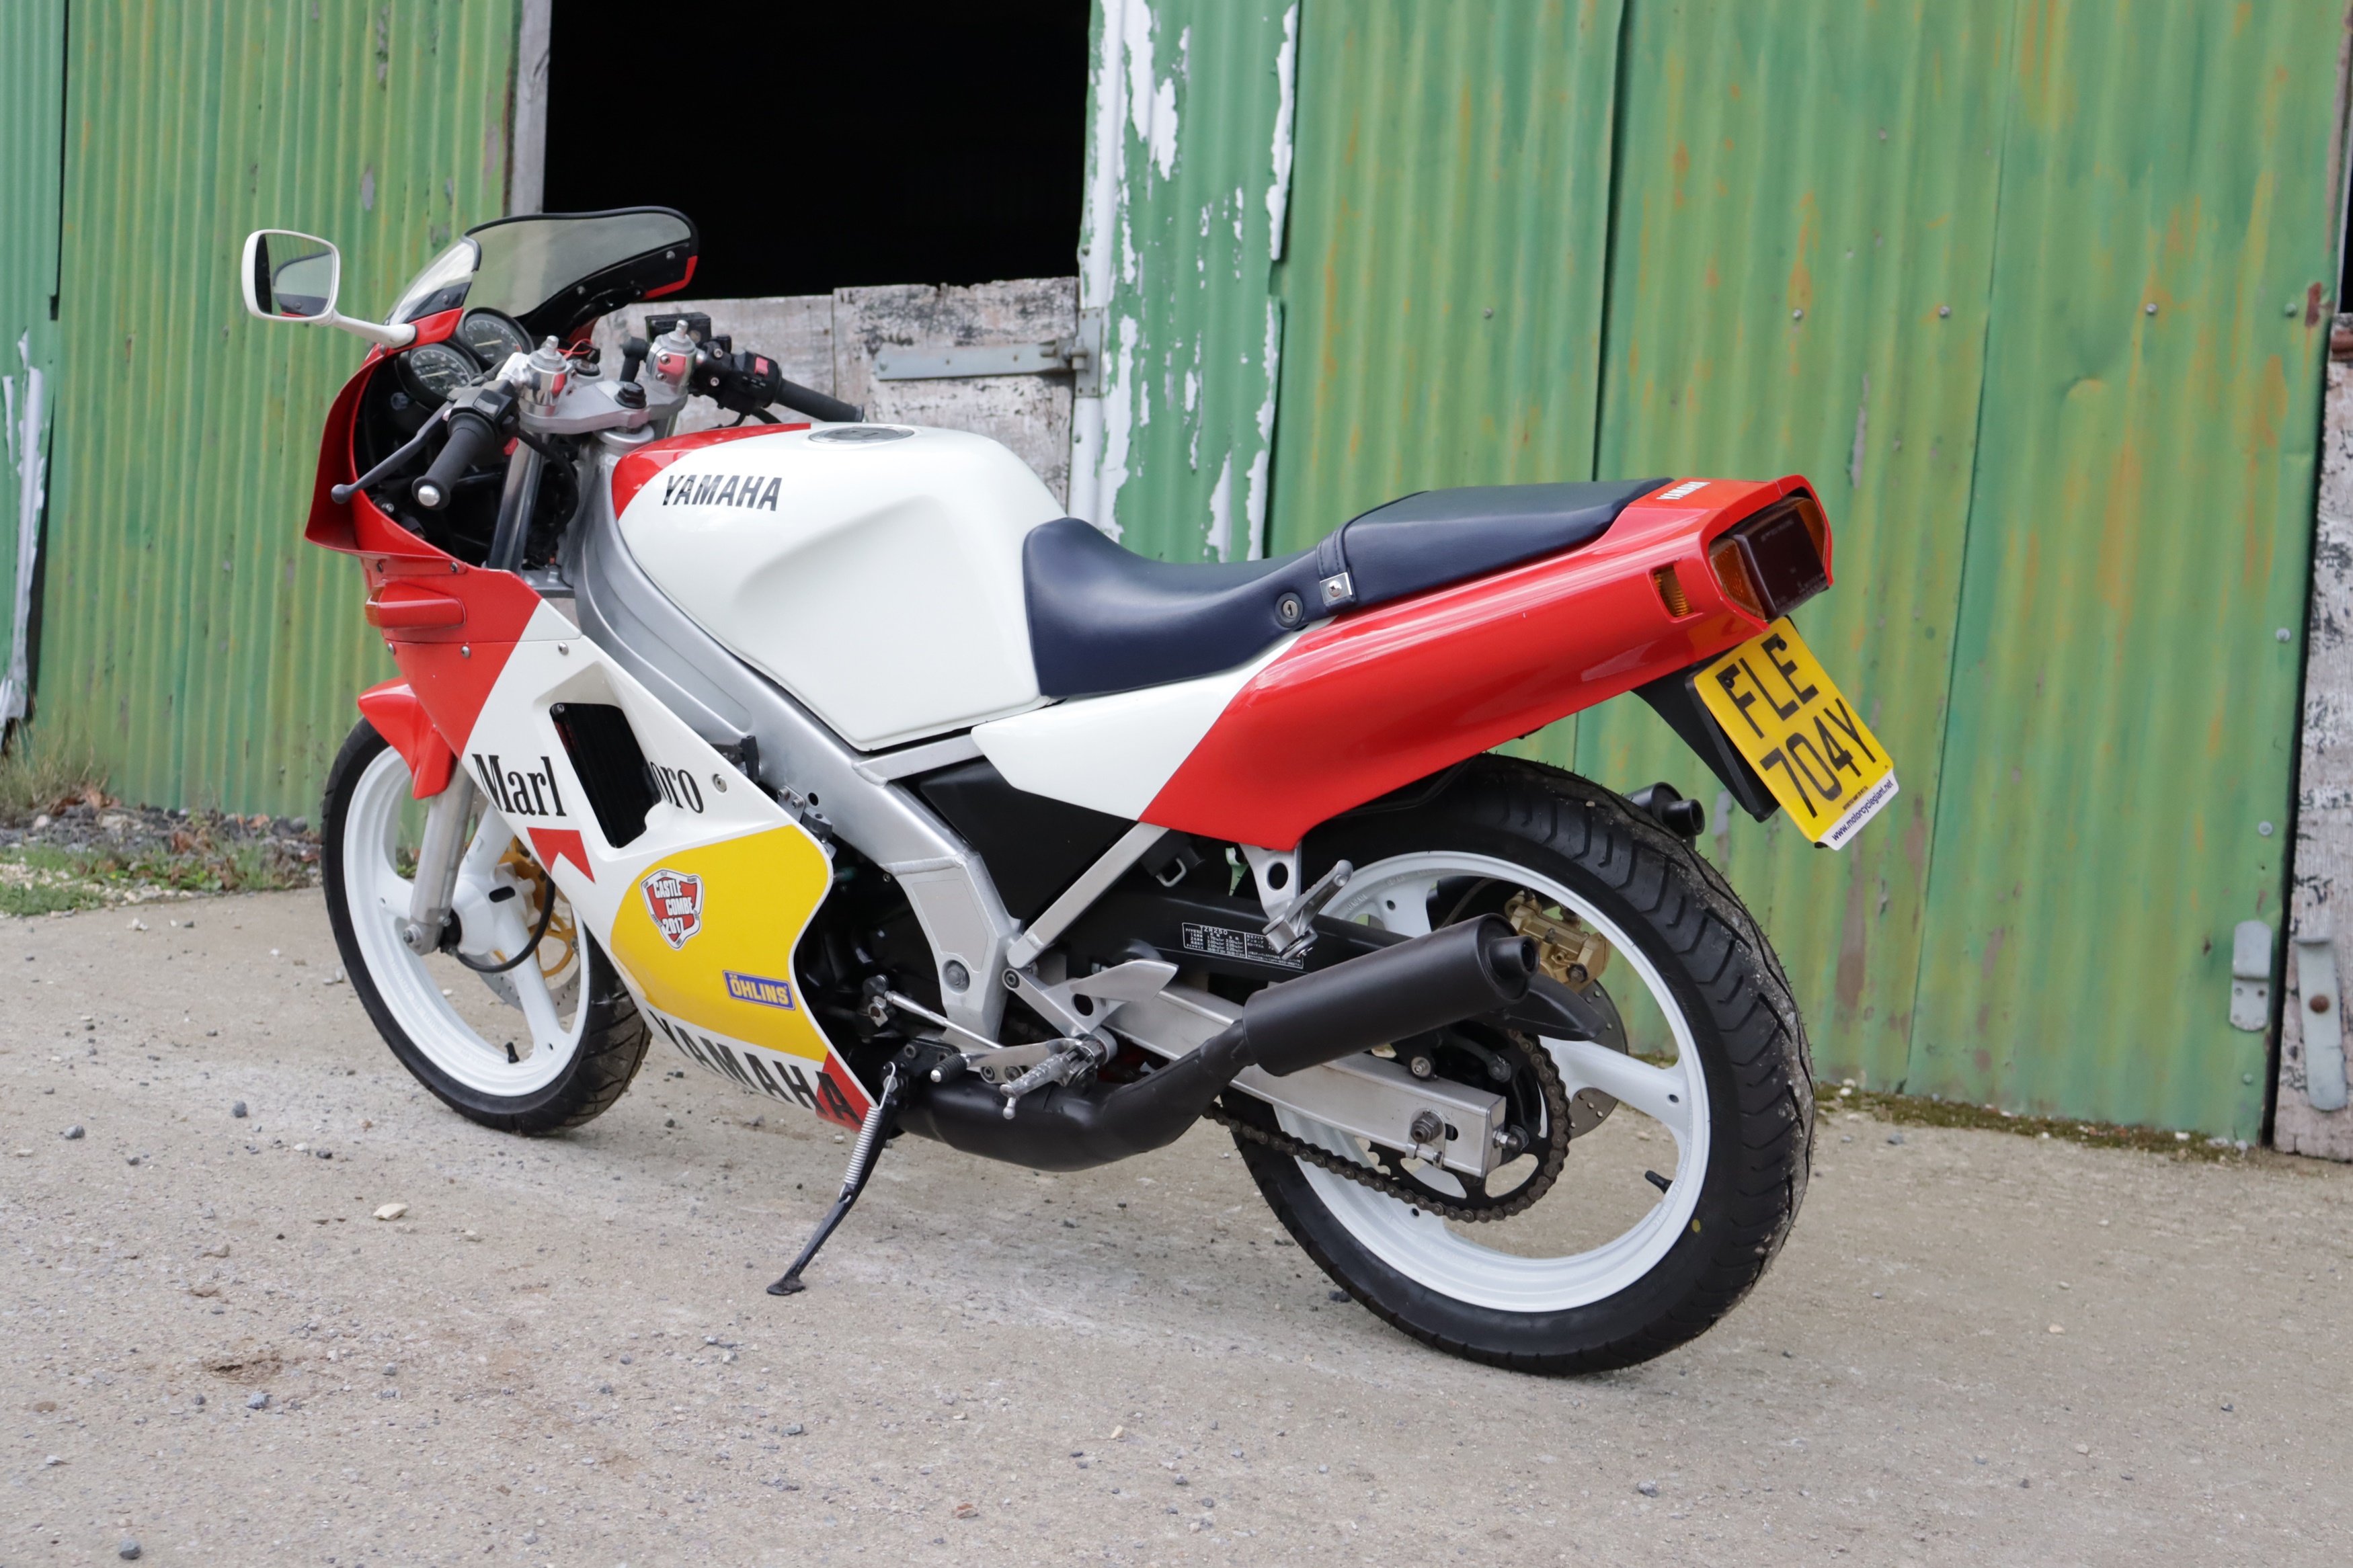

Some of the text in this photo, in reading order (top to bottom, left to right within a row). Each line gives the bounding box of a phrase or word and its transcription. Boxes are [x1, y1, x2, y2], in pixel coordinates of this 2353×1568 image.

[663, 474, 783, 511] YAMAHA
[1656, 481, 1711, 500] YAMAHA
[1715, 633, 1820, 739] FLE
[1759, 697, 1877, 819] 704Y
[1831, 778, 1894, 841] www.motorcyclegiant.net
[653, 879, 682, 899] CASTLE
[665, 897, 694, 916] COMBE
[662, 917, 684, 934] 2017
[1199, 925, 1228, 935] TZR250
[729, 974, 789, 1005] ÖHLINS
[646, 1008, 863, 1126] YAMAHA
